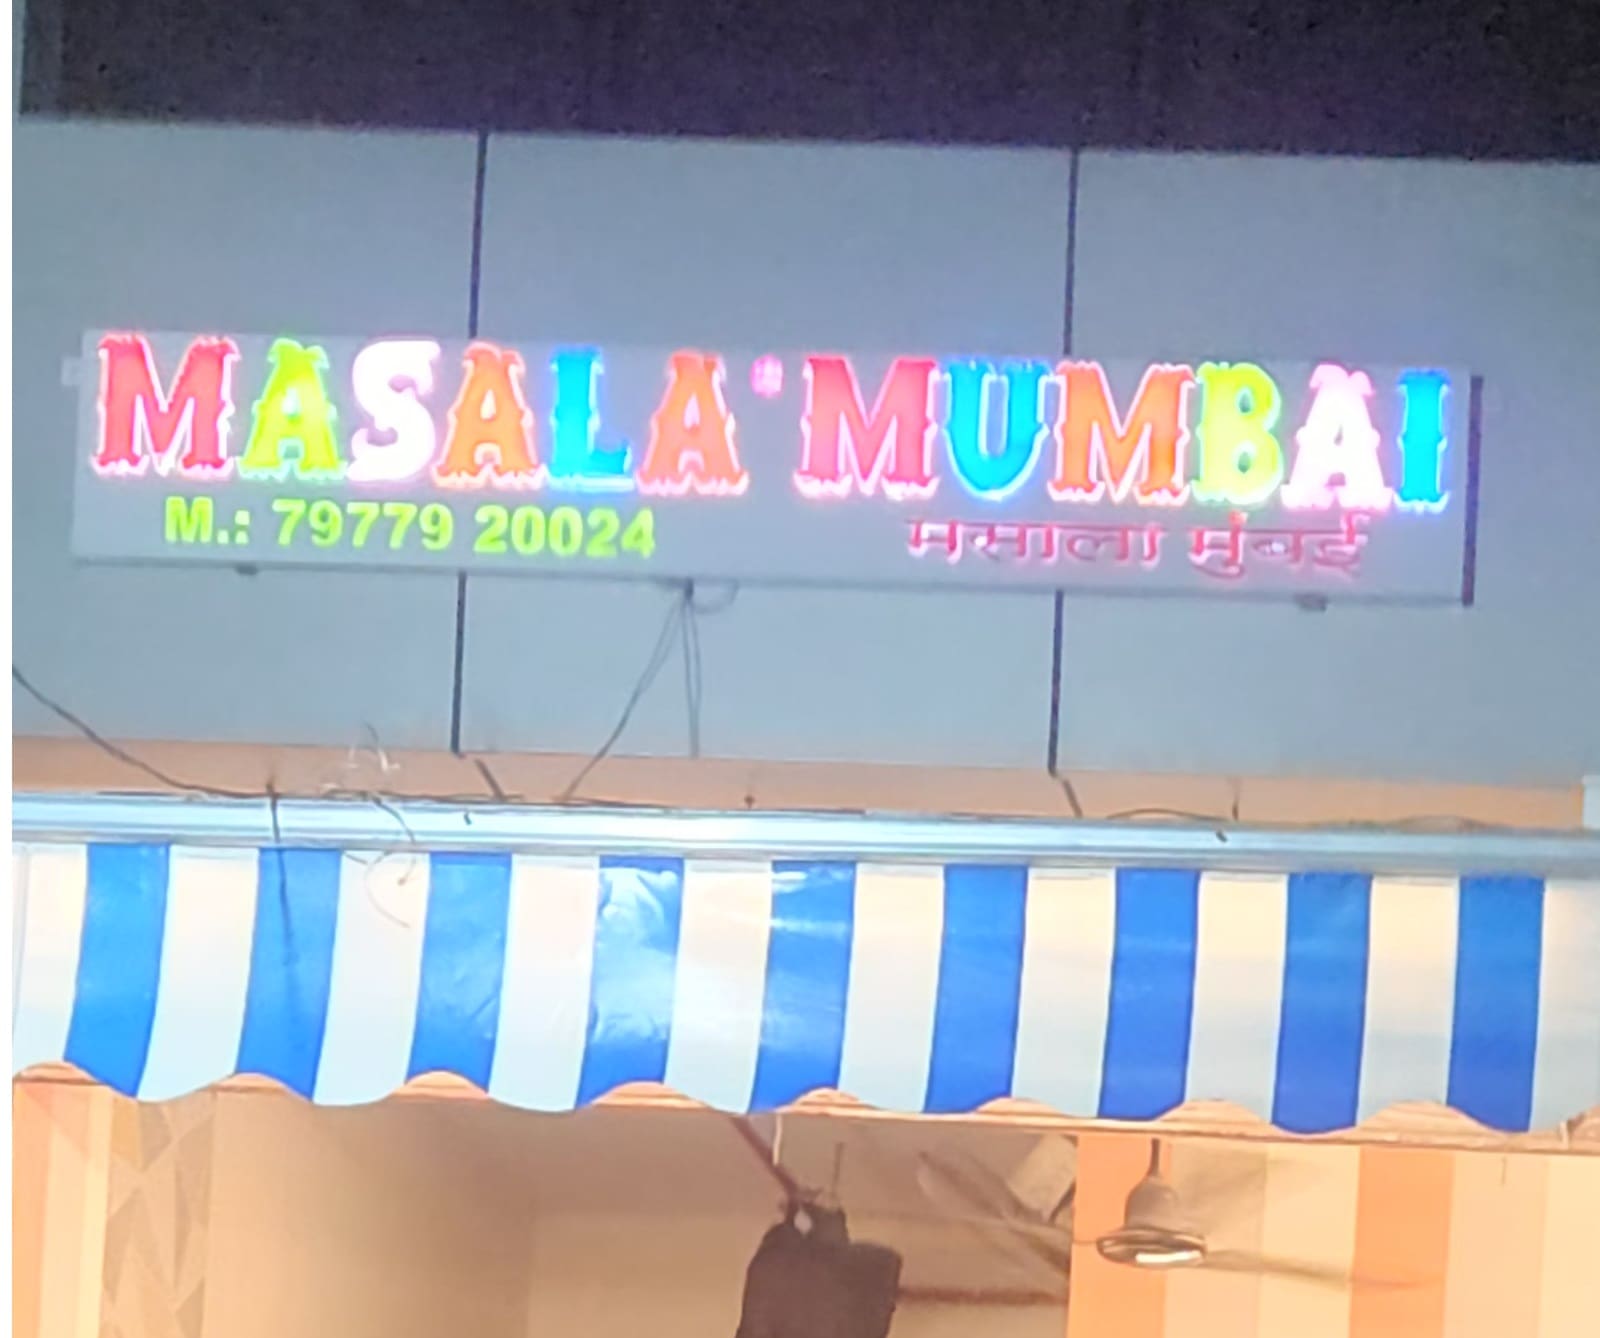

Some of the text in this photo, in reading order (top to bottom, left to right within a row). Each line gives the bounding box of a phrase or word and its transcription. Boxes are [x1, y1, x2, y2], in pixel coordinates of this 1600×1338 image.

[793, 355, 1448, 512] MUMBAI
[272, 499, 453, 551] 79779
[474, 506, 655, 558] 20024
[906, 518, 1167, 568] मसाला
